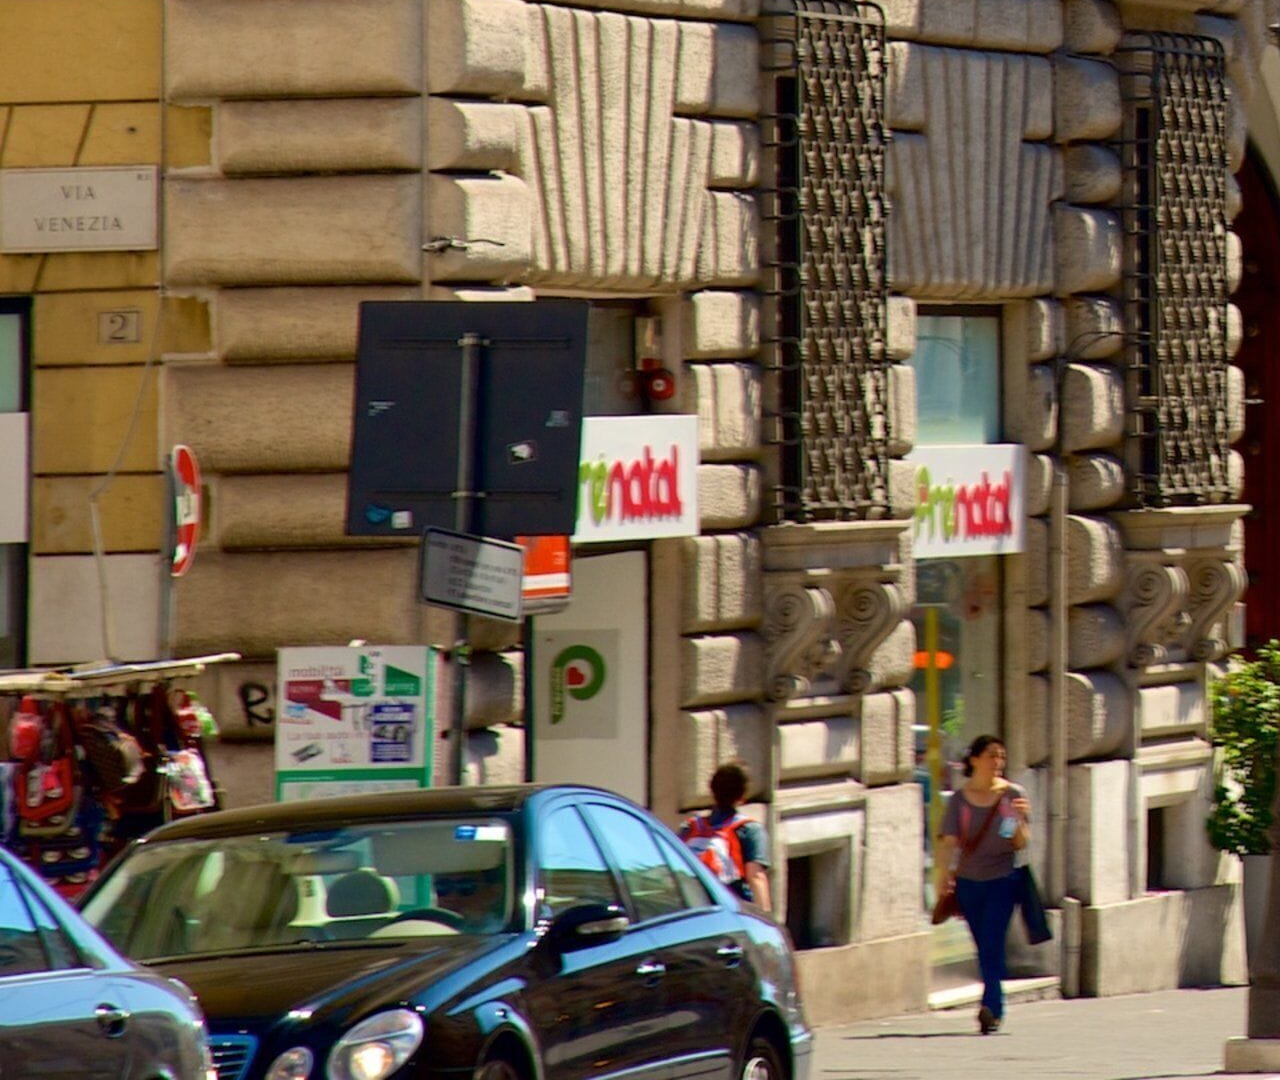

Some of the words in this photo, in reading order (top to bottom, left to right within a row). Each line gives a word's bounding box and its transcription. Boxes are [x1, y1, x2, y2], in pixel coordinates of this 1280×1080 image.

[60, 185, 96, 200] VIA
[34, 217, 123, 232] VENEZIA
[109, 314, 127, 340] 2
